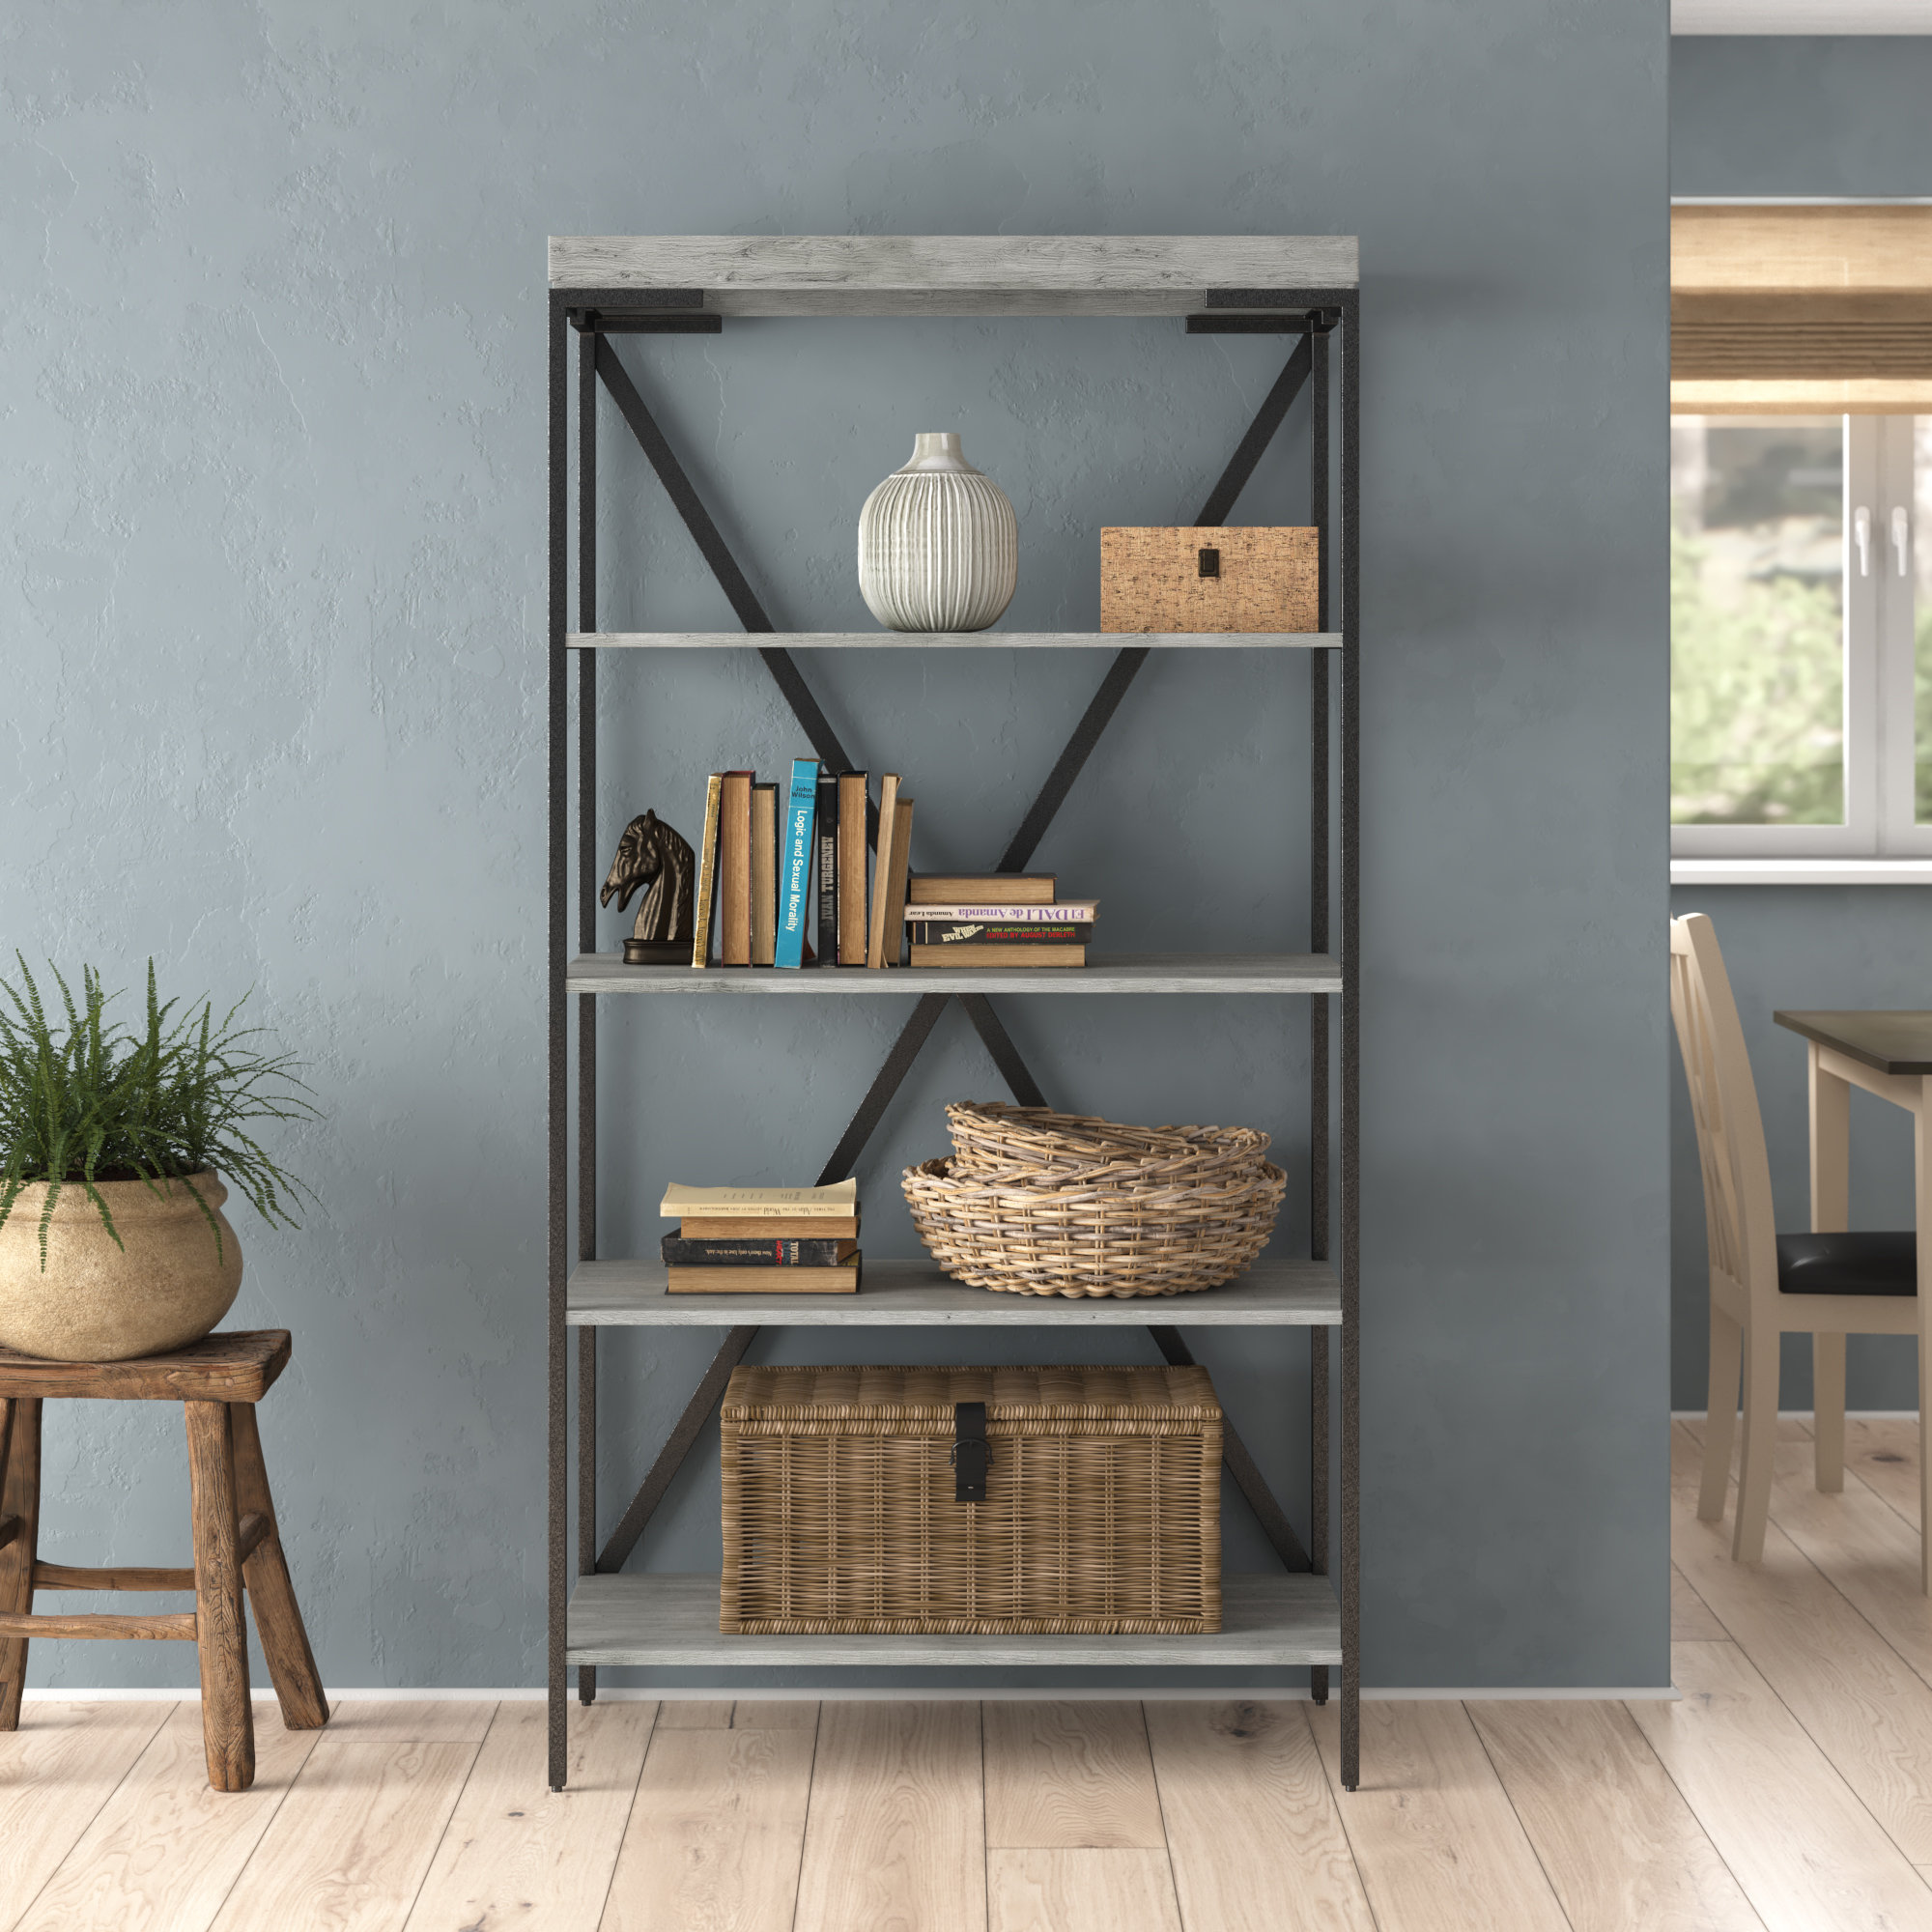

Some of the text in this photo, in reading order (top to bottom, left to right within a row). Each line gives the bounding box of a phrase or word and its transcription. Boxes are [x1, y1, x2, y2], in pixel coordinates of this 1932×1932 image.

[791, 791, 815, 800] Wilson
[785, 810, 808, 932] Logic and Sexual Morality
[821, 836, 835, 921] IVAN TURGENEV
[958, 908, 1084, 921] El DALI de Amanda
[941, 932, 964, 943] EVIL
[790, 1241, 800, 1266] TOTAL
